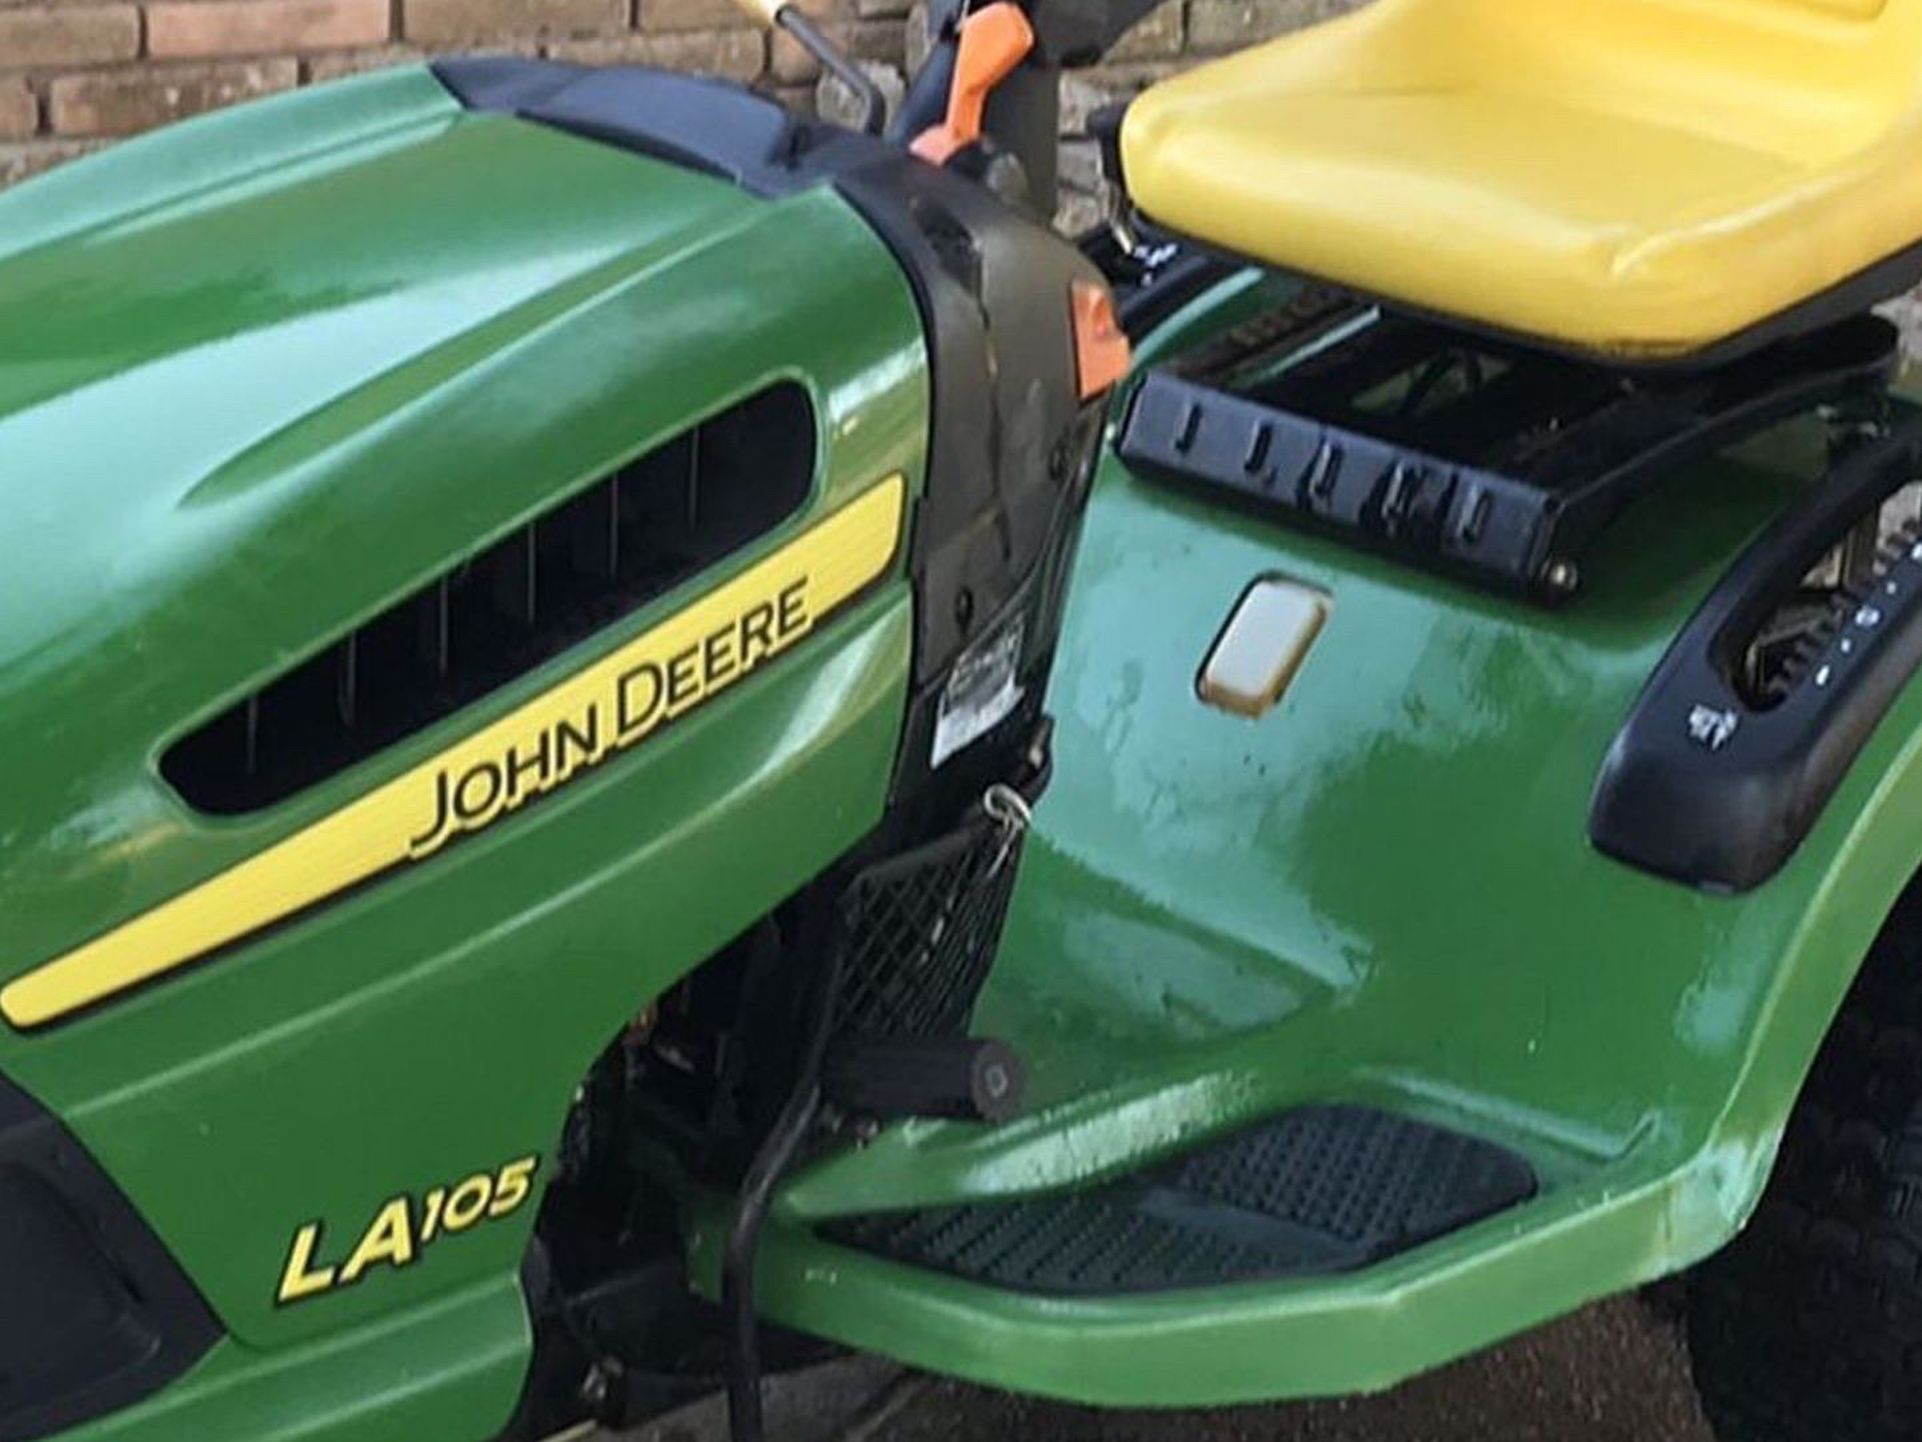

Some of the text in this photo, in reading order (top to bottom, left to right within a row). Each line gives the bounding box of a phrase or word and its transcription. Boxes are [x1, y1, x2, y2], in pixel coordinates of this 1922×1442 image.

[410, 703, 598, 850] JOHN
[616, 576, 809, 737] DEERE
[277, 1154, 537, 1303] LA105
